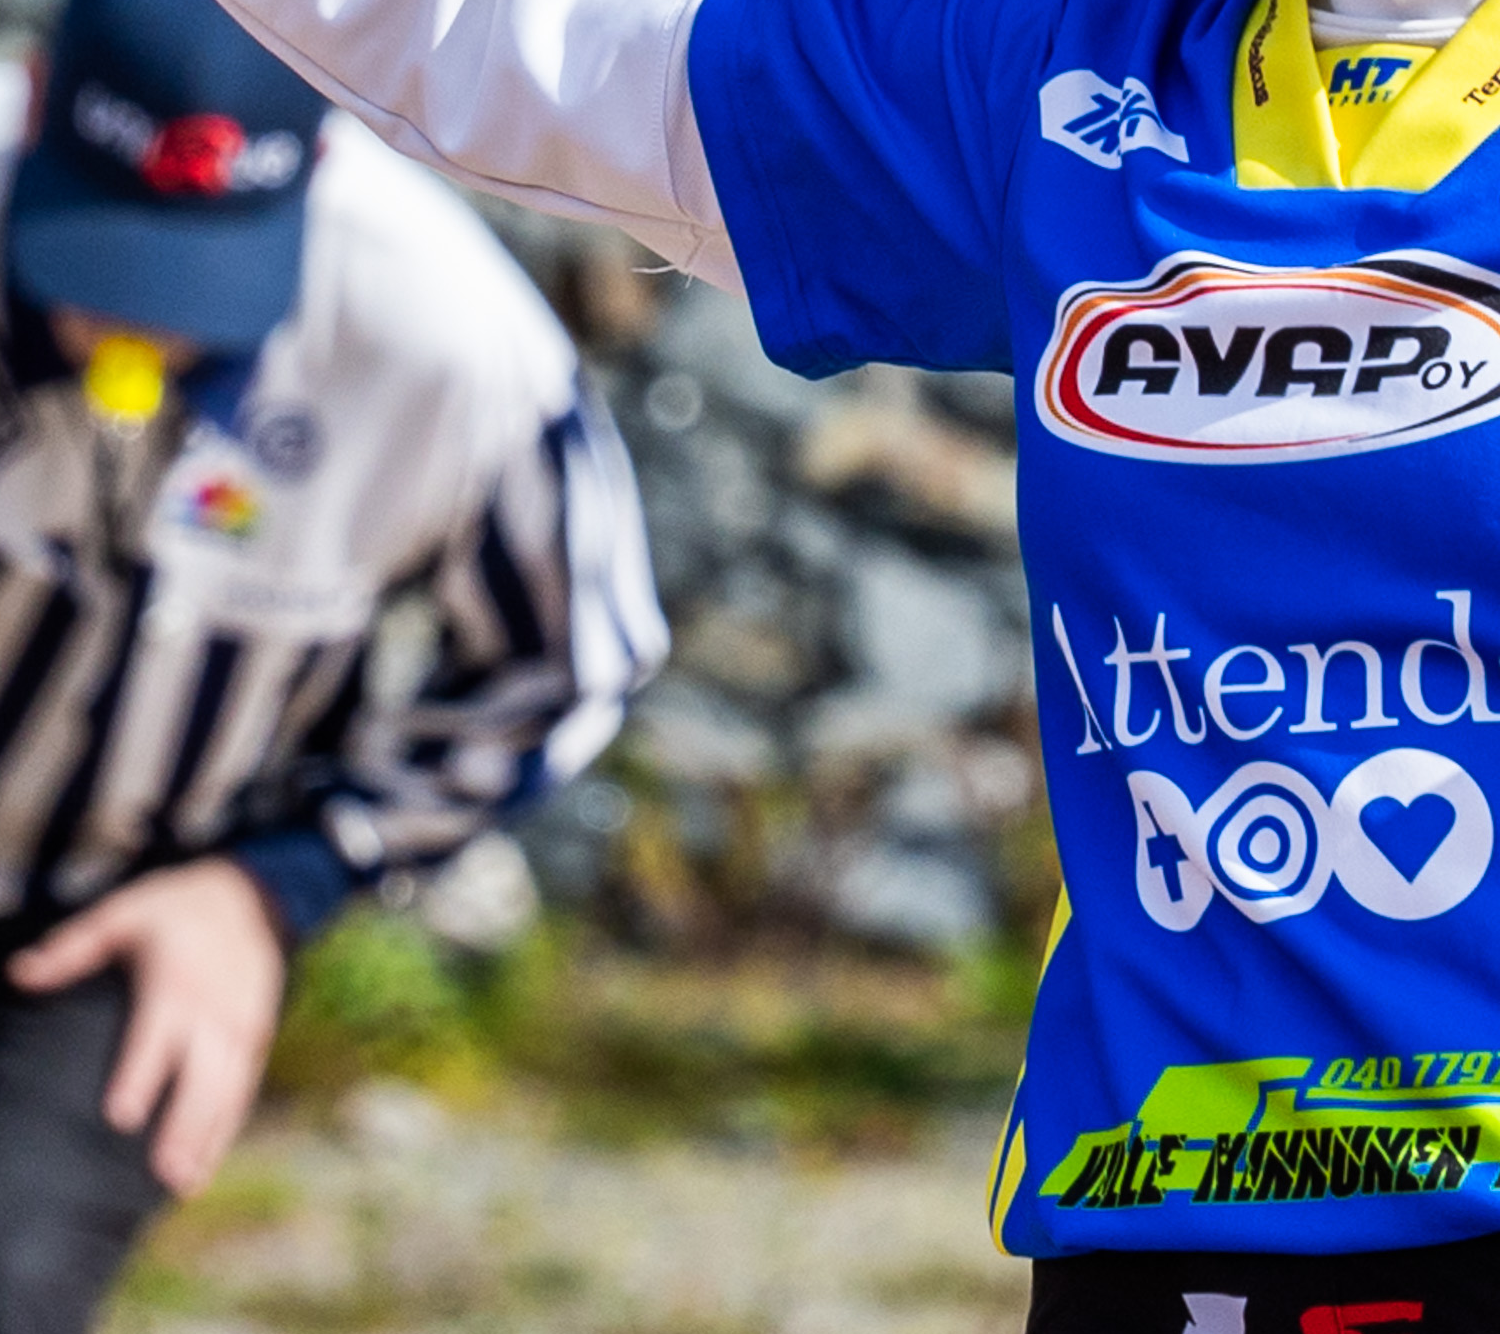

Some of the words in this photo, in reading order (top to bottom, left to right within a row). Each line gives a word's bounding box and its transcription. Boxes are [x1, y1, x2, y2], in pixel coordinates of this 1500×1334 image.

[1329, 57, 1412, 94] HT
[1092, 324, 1453, 397] AVAP
[1420, 360, 1488, 390] OY
[1320, 1057, 1402, 1089] 040
